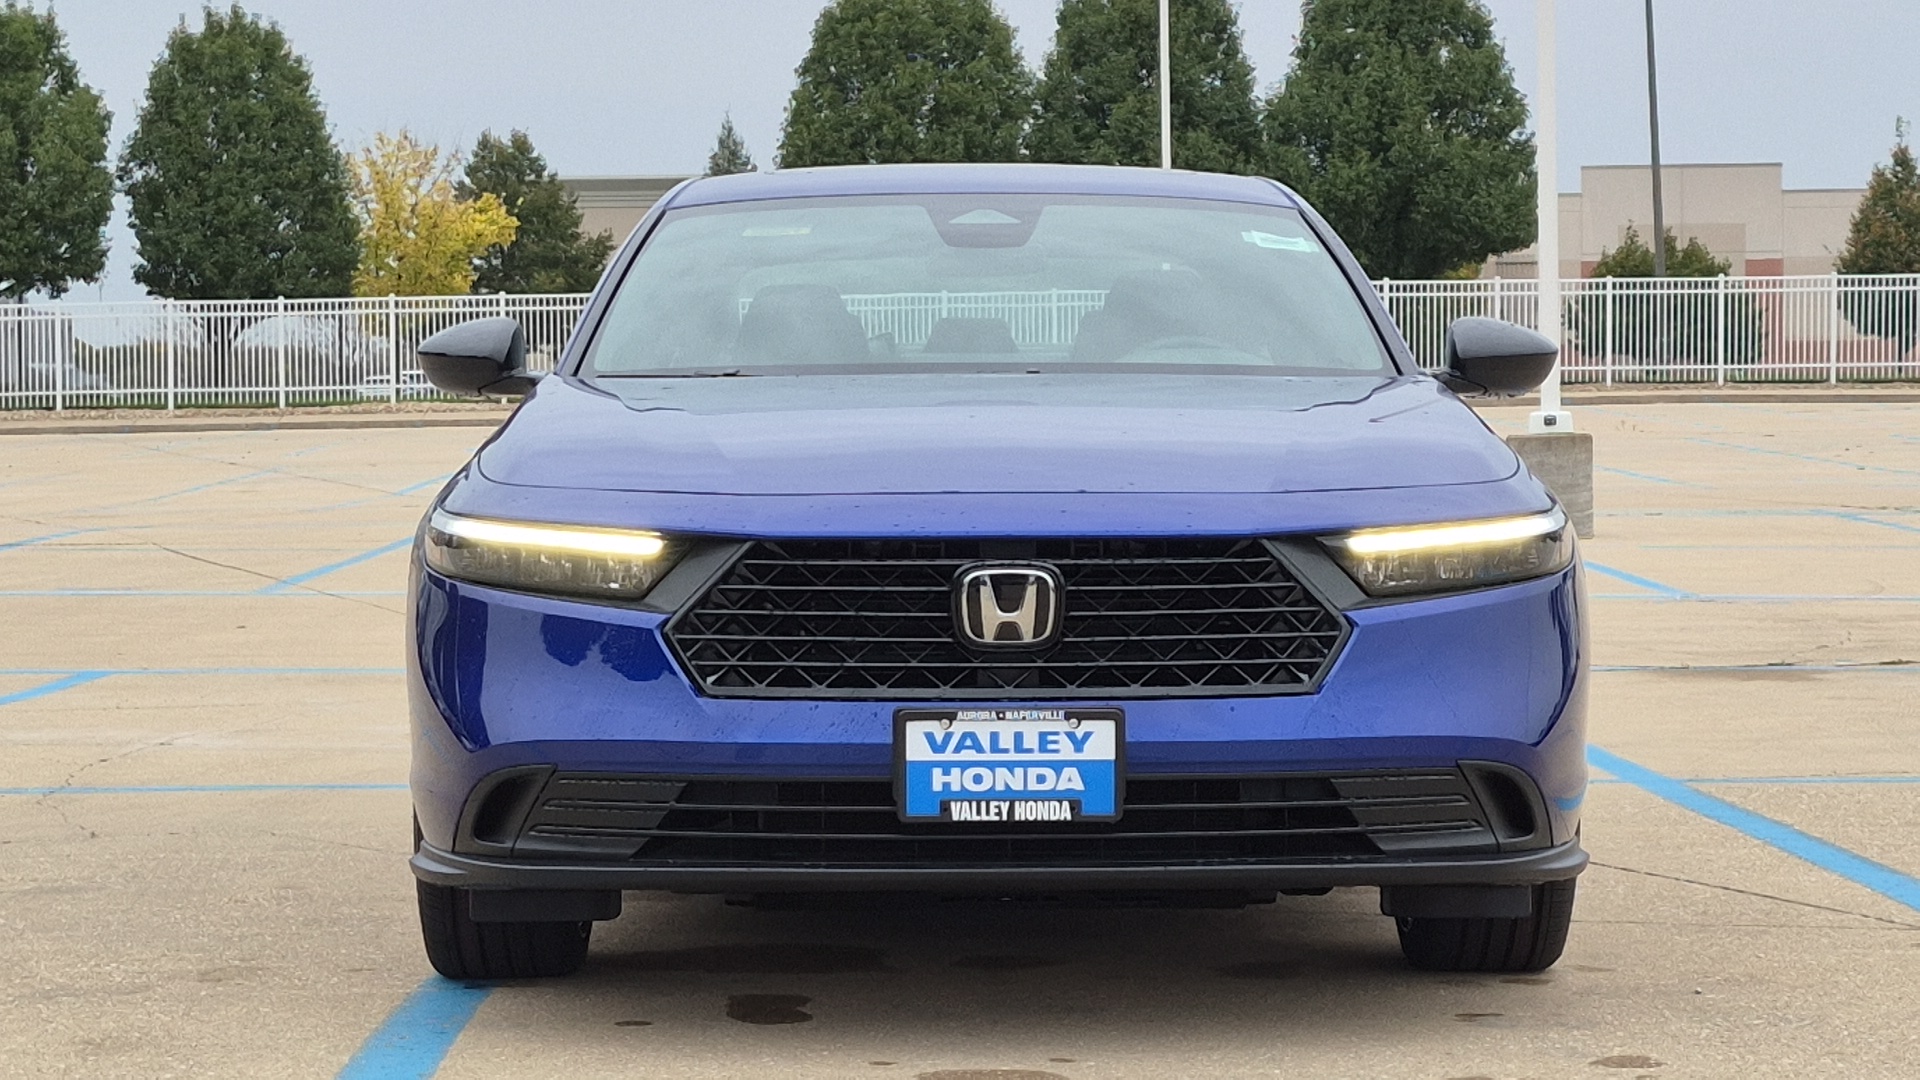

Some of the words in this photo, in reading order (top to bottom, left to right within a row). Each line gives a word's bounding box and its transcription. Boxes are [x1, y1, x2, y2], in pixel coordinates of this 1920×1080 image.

[979, 573, 1038, 642] H
[956, 710, 997, 720] AURORA
[923, 731, 1095, 754] VALLEY
[932, 767, 1086, 792] HONDA
[950, 800, 1011, 822] VALLEY
[1014, 800, 1072, 822] HONDA
